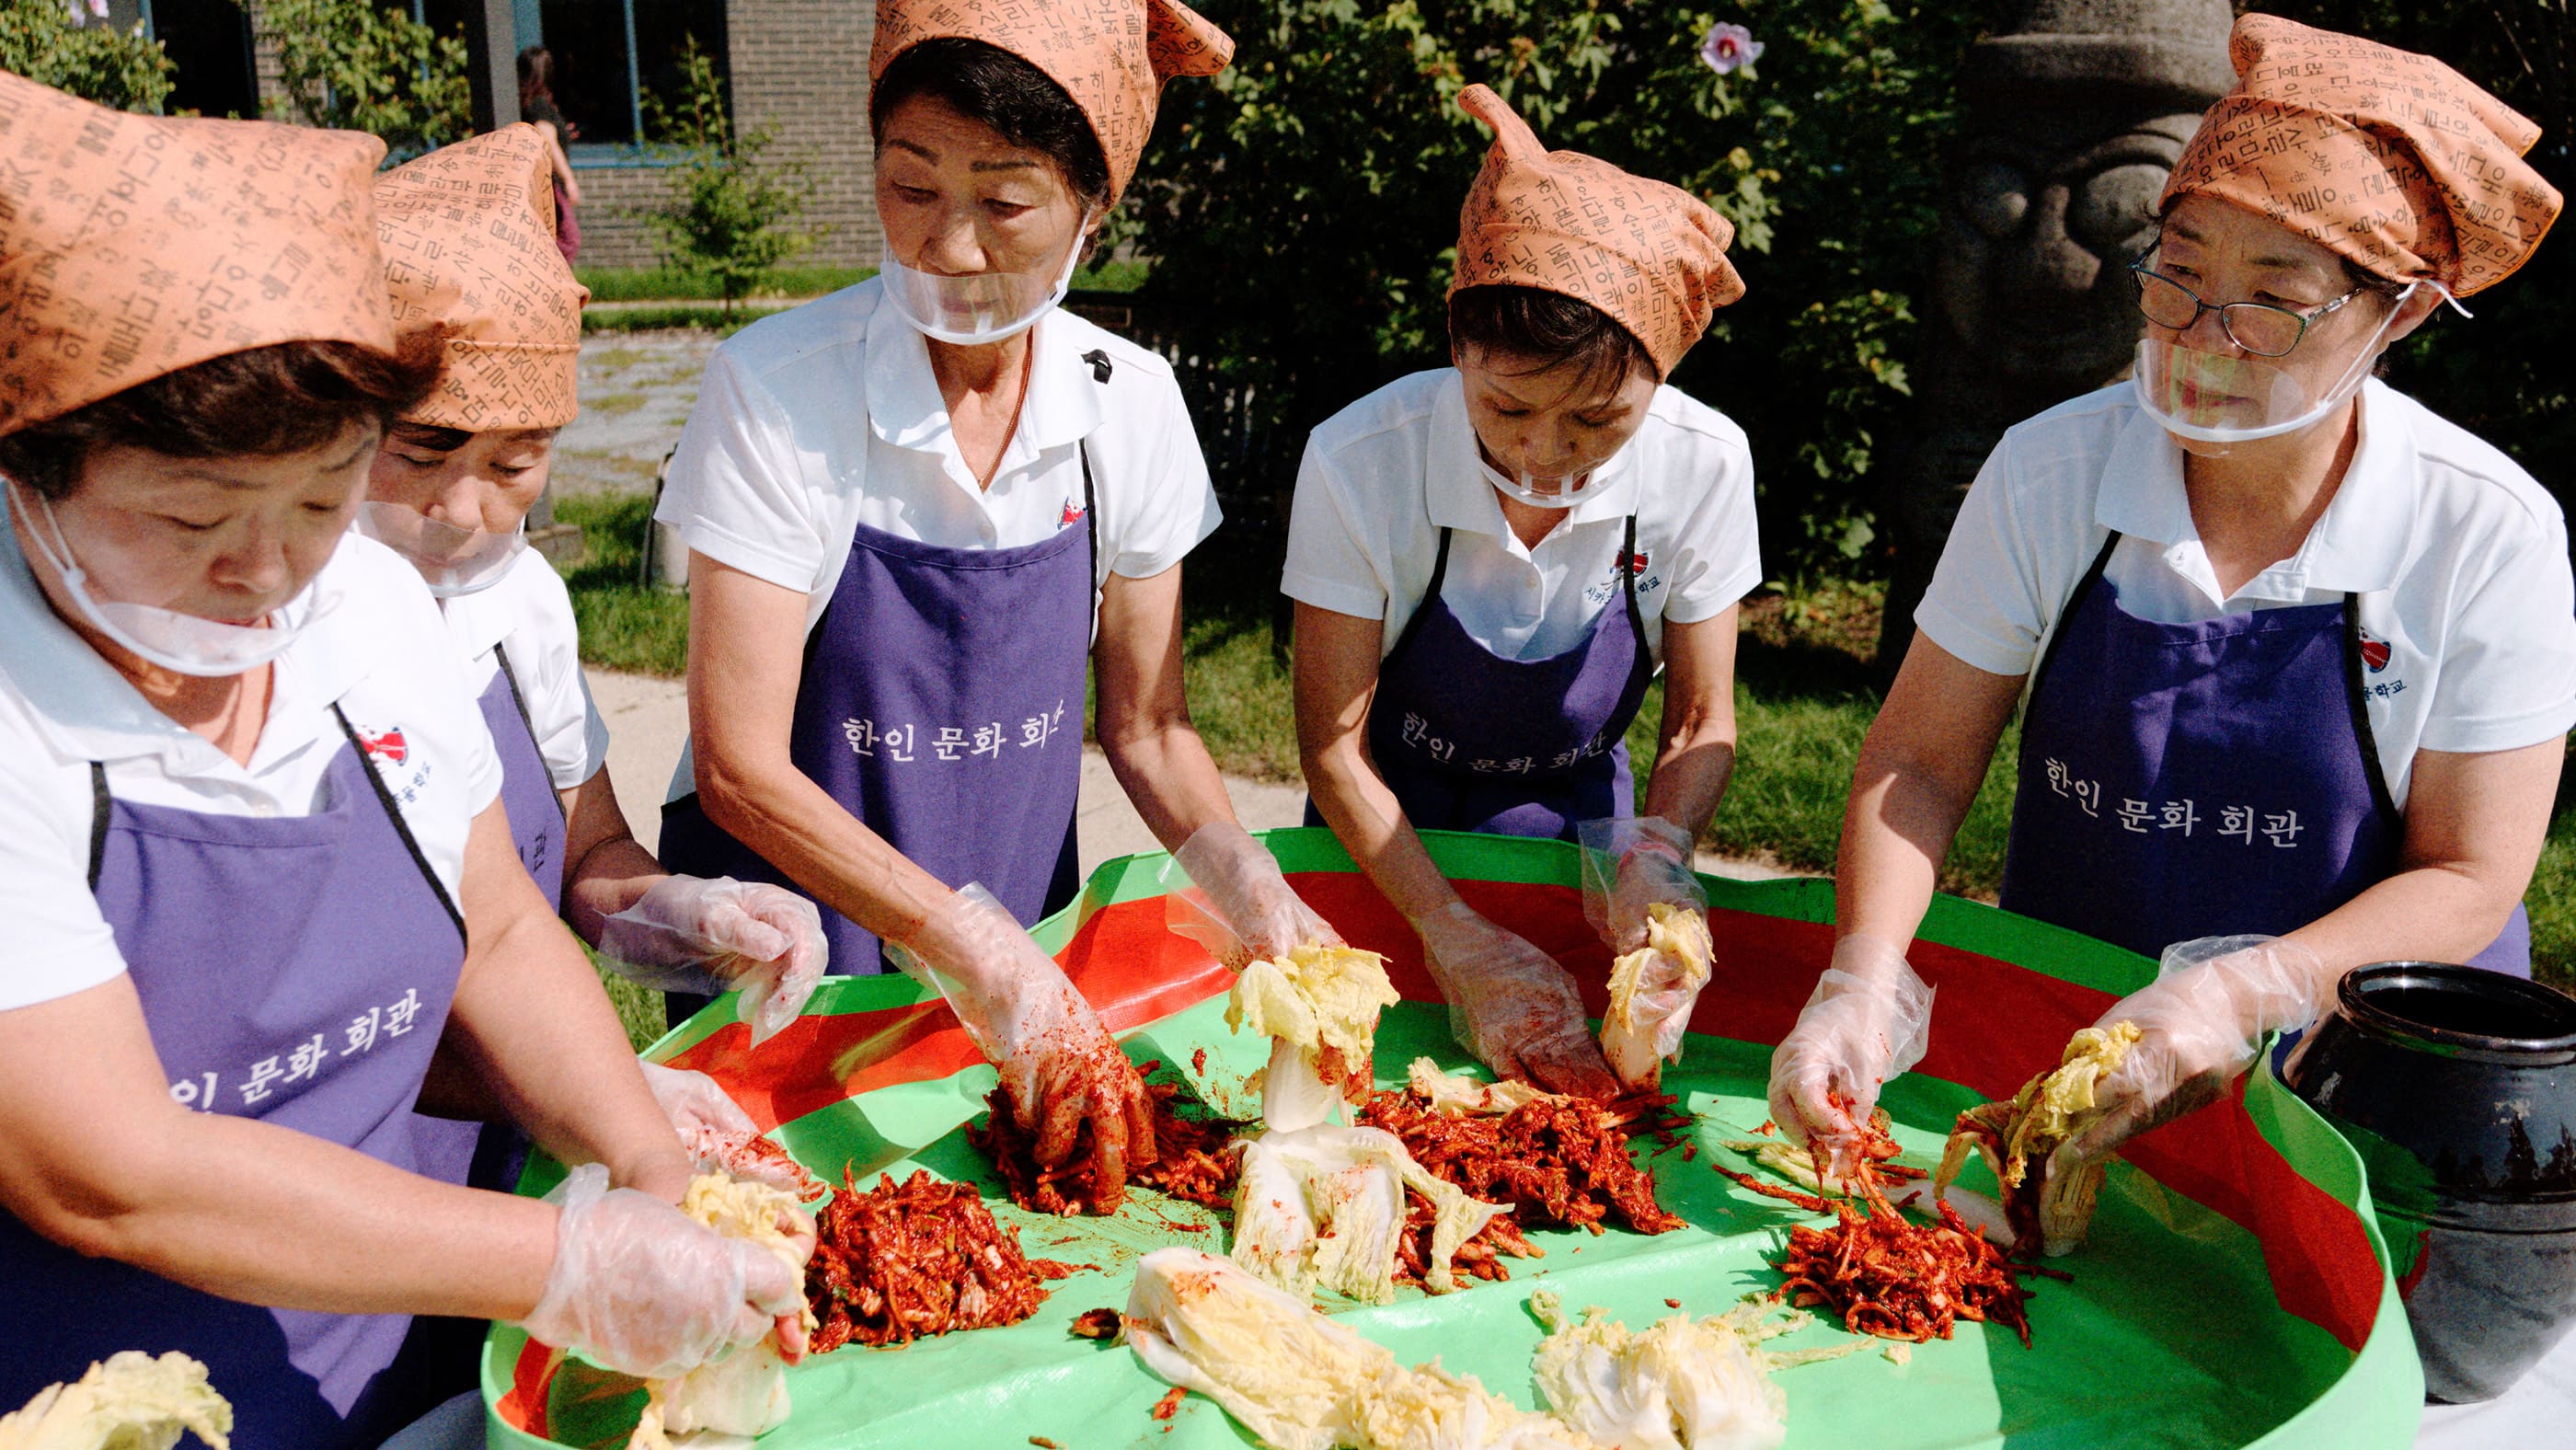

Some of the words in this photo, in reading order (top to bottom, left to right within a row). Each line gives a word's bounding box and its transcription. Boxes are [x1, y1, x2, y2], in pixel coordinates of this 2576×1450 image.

[841, 717, 914, 763] 한인
[931, 721, 1007, 761] 문화
[1401, 711, 1456, 765] 한인
[1469, 755, 1537, 775] 문화
[2044, 755, 2101, 819] 한인
[2115, 798, 2202, 838] 문화
[2216, 804, 2305, 848] 회관
[169, 1071, 219, 1114] 인
[238, 1033, 329, 1105] 문화
[339, 987, 423, 1057] 회관
